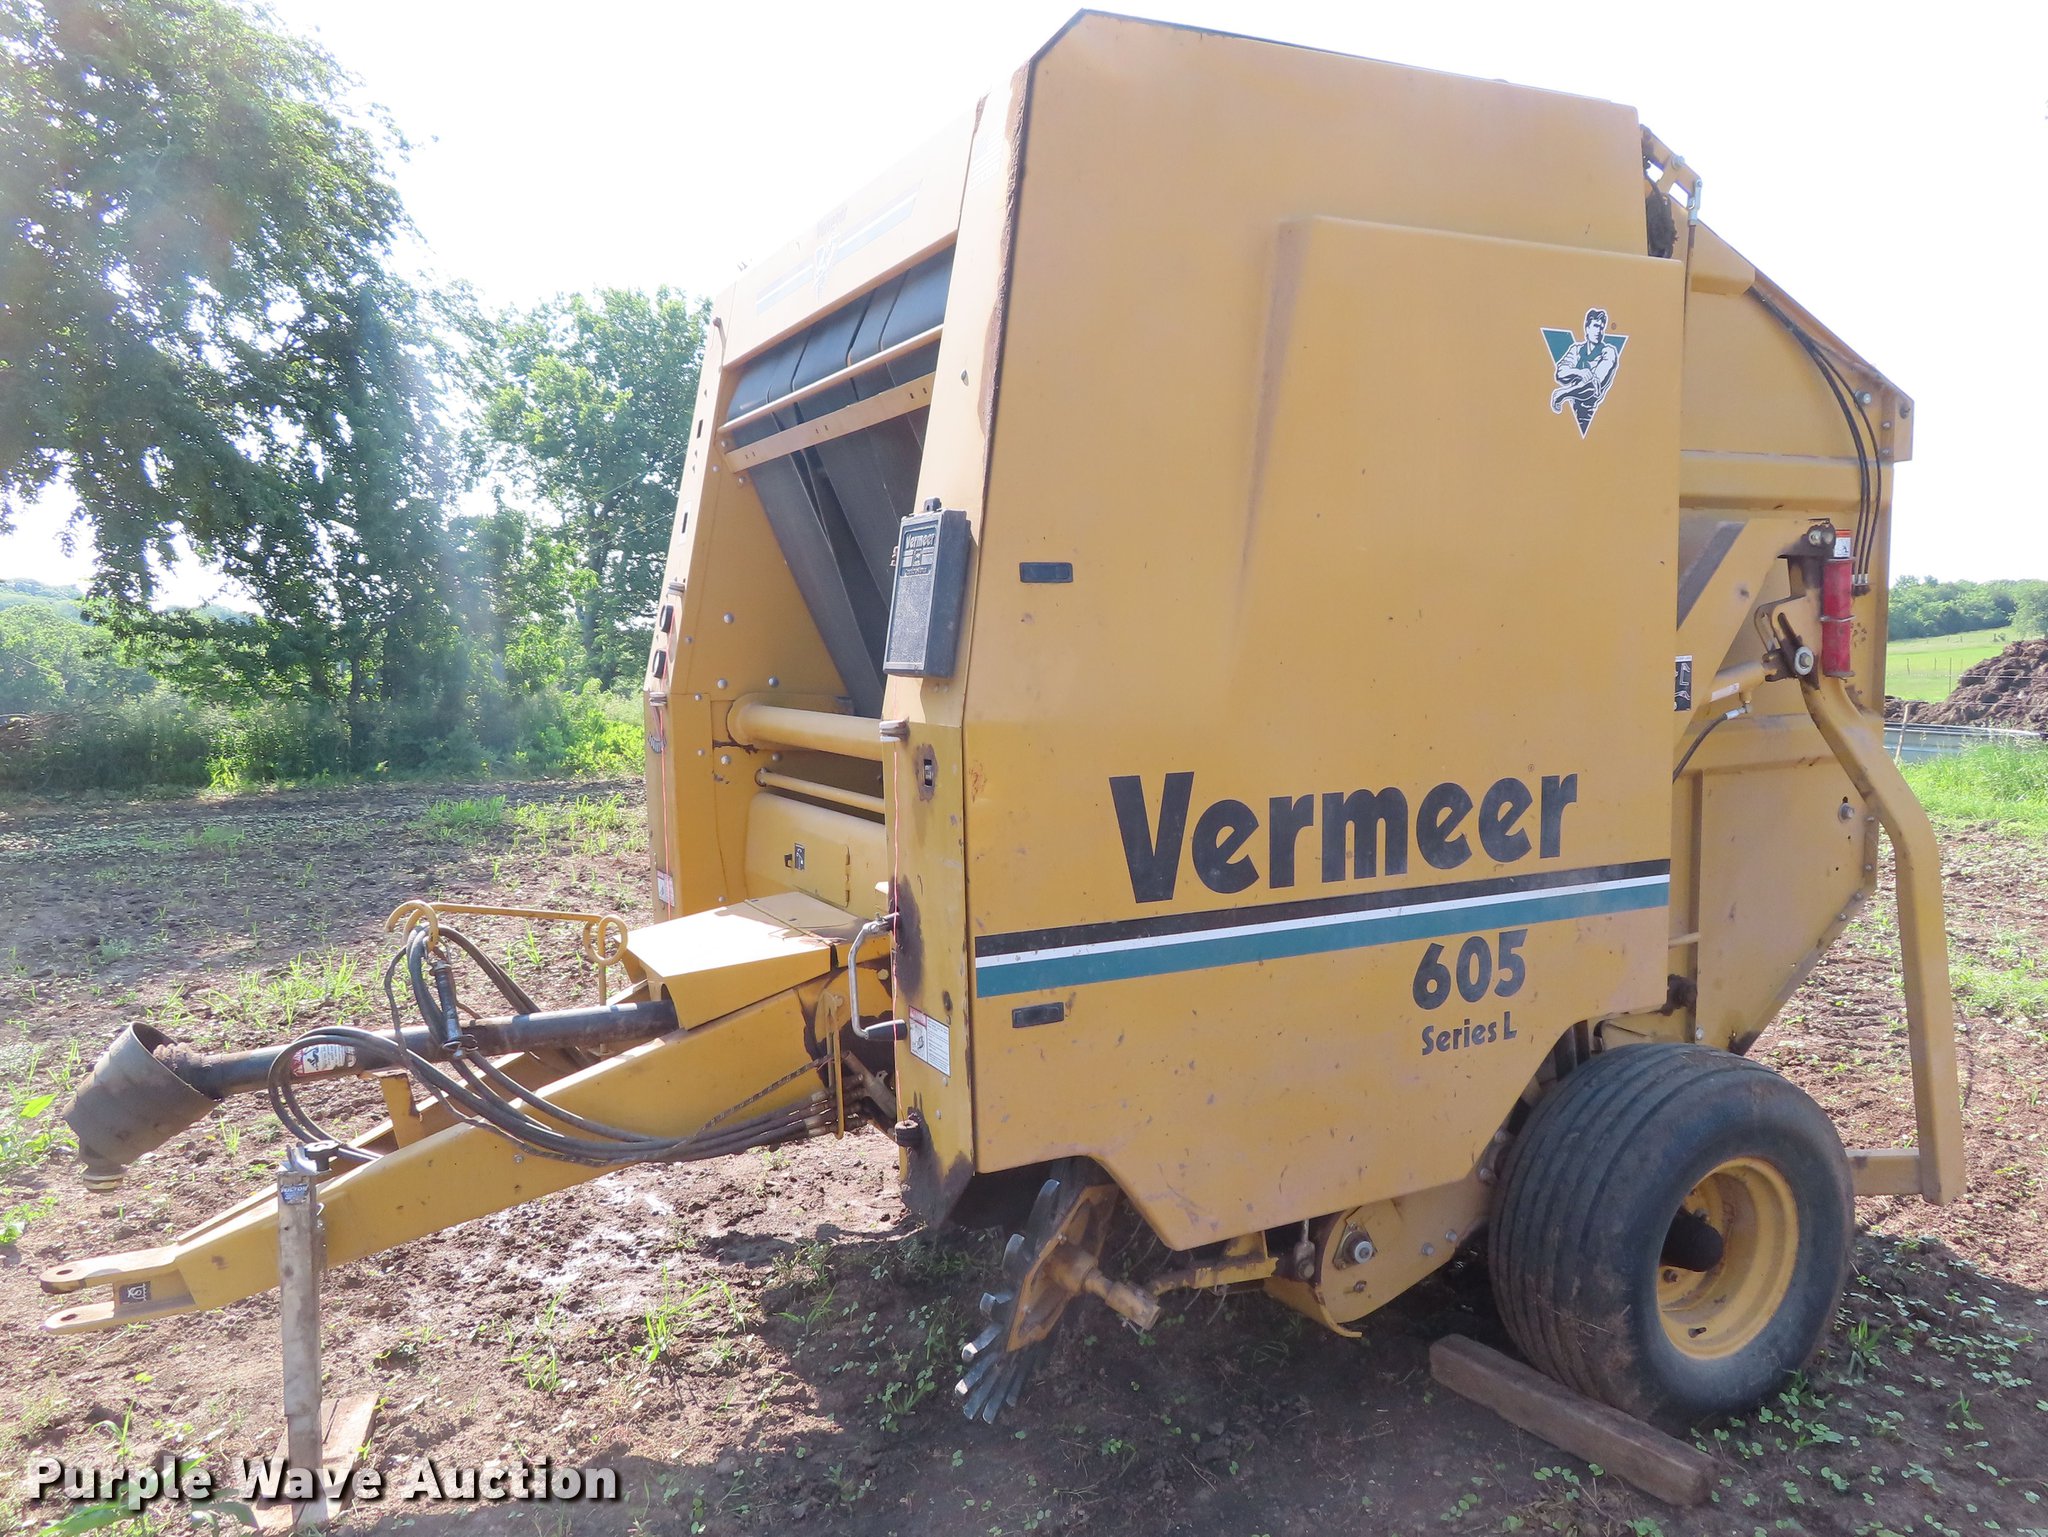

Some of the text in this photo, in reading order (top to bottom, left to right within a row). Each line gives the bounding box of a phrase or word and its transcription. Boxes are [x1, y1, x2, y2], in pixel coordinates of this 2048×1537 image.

[1109, 771, 1578, 904] Vermeer
[1412, 928, 1528, 1011] 605
[1421, 1010, 1518, 1056] Series L
